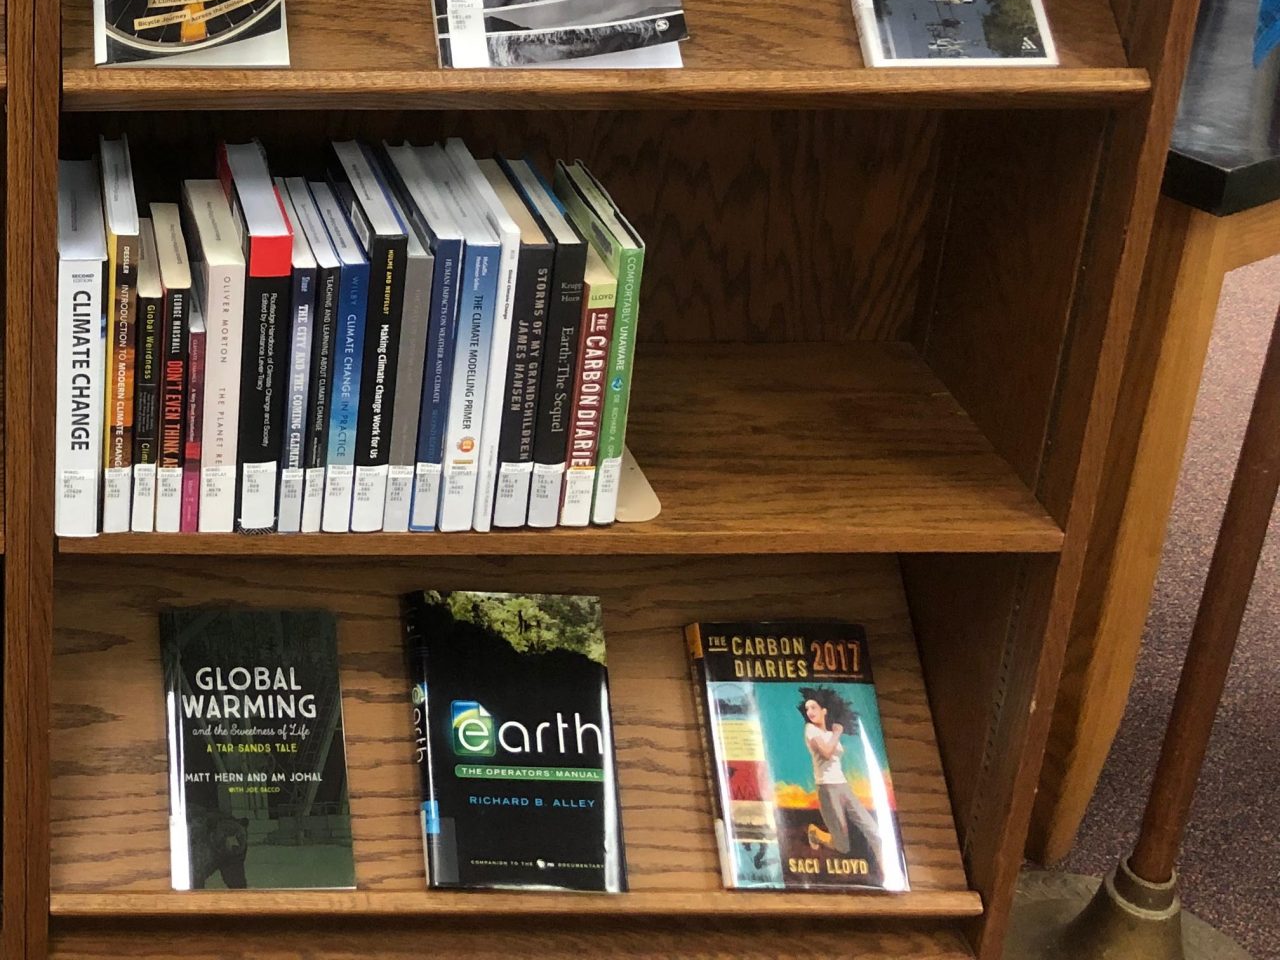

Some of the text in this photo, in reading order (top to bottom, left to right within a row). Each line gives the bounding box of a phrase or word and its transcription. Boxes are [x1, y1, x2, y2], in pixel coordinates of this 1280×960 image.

[71, 290, 91, 368] CLIMATE
[463, 295, 484, 429] THE CLIMATE MODELLING PRIMER
[510, 320, 528, 411] JAMES HANSEN
[519, 268, 548, 460] STORMS OF MY GRANDCHILDREN
[551, 327, 573, 432] Earth: The Sequel
[71, 373, 91, 451] CHANGE
[164, 360, 183, 454] DON'T EVEN THINK
[370, 325, 389, 458] Making Climate Change Work for Us
[708, 636, 861, 673] THE CARBON 2017
[734, 659, 808, 678] DIARIES
[195, 666, 302, 691] GLOBAL
[182, 694, 317, 720] WARMING
[457, 712, 605, 754] earth
[185, 772, 323, 783] MATT HERN AND AM JOHAL
[461, 768, 482, 776] THE
[556, 770, 600, 779] MANUAL
[470, 796, 530, 807] RICHARD
[553, 798, 596, 808] ALLEY
[789, 858, 869, 875] SACI LLOYD
